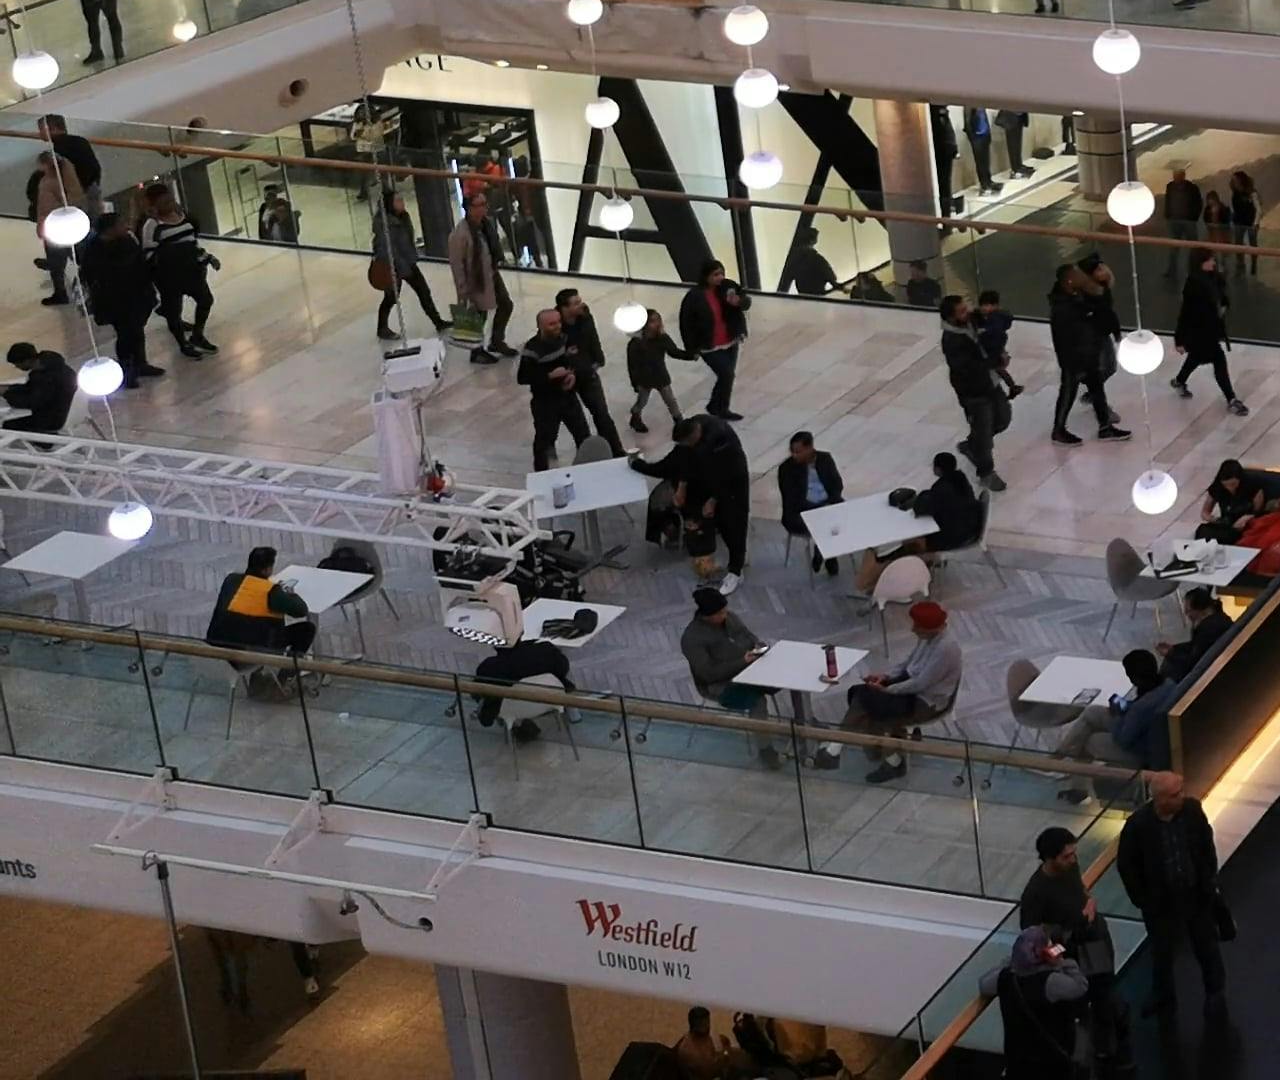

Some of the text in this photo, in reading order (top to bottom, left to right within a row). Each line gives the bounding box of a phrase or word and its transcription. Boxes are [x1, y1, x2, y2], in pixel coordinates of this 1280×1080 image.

[0, 858, 37, 879] nts
[576, 898, 699, 953] Westfield
[597, 949, 692, 980] LONDON W12
